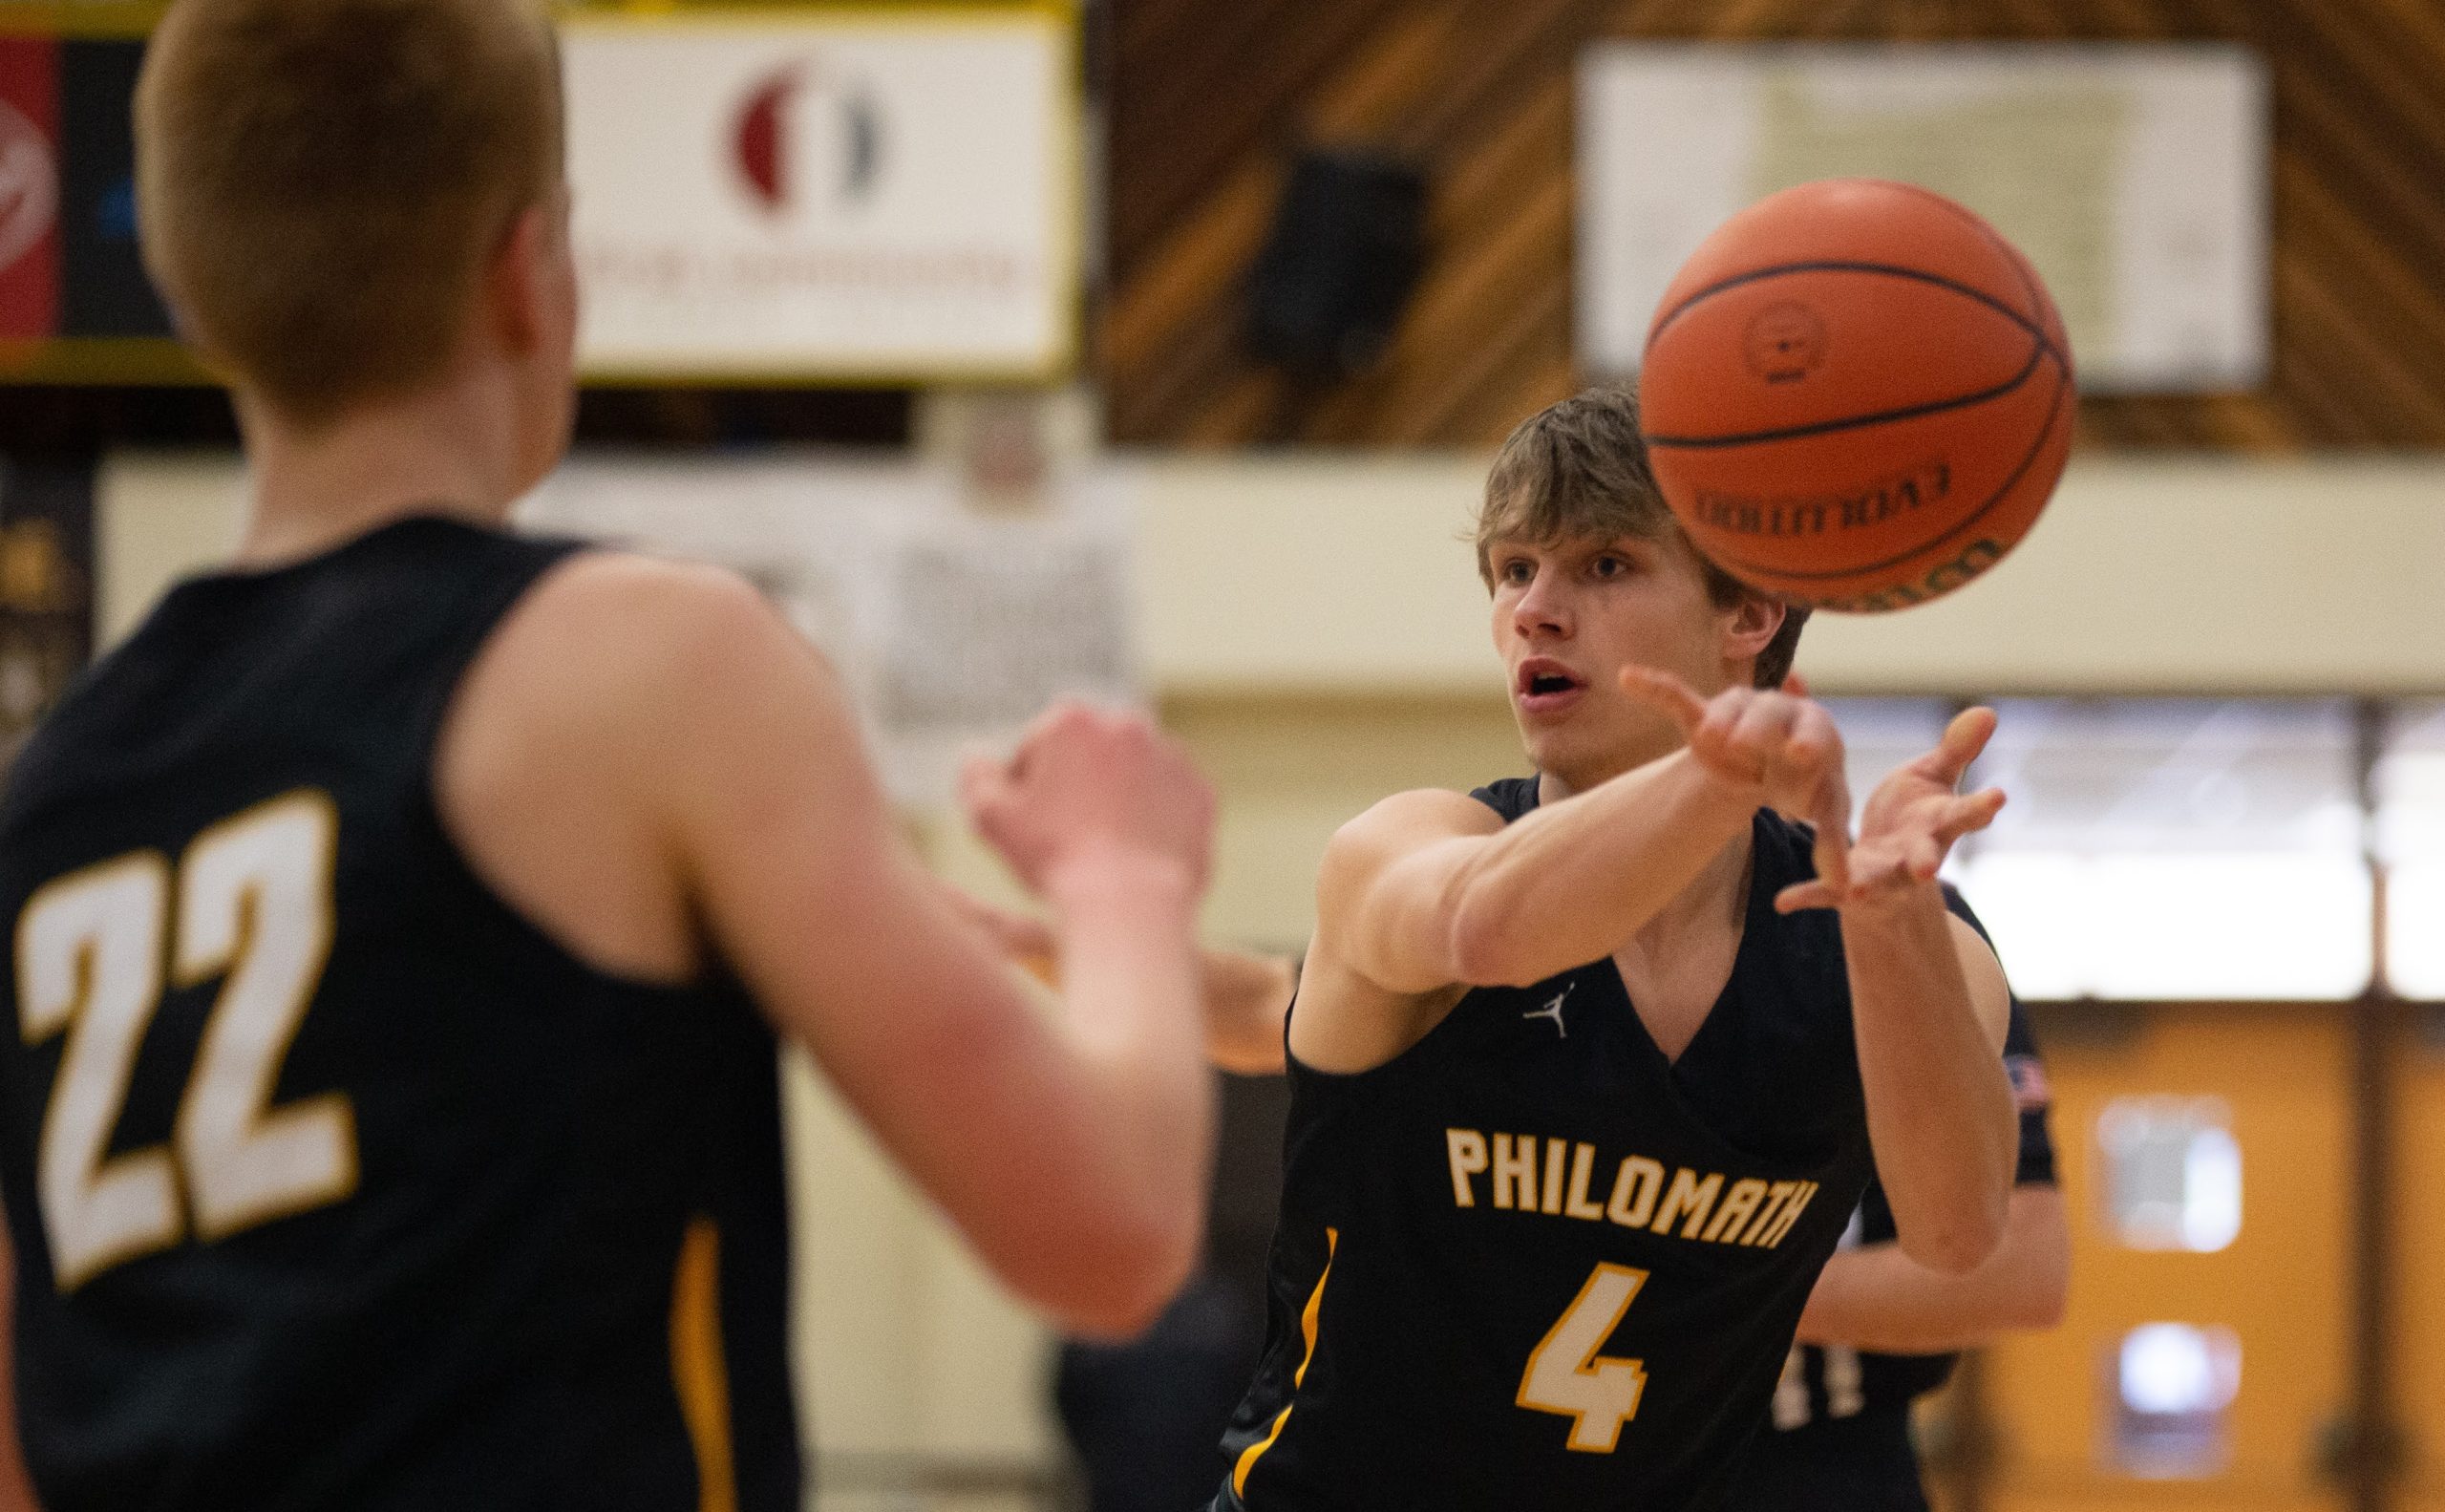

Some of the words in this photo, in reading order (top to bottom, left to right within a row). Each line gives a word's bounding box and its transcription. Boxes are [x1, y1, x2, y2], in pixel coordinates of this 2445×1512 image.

[13, 784, 360, 1295] 22
[1446, 1127, 1819, 1249] PHILOMATH
[1515, 1261, 1651, 1454] 4
